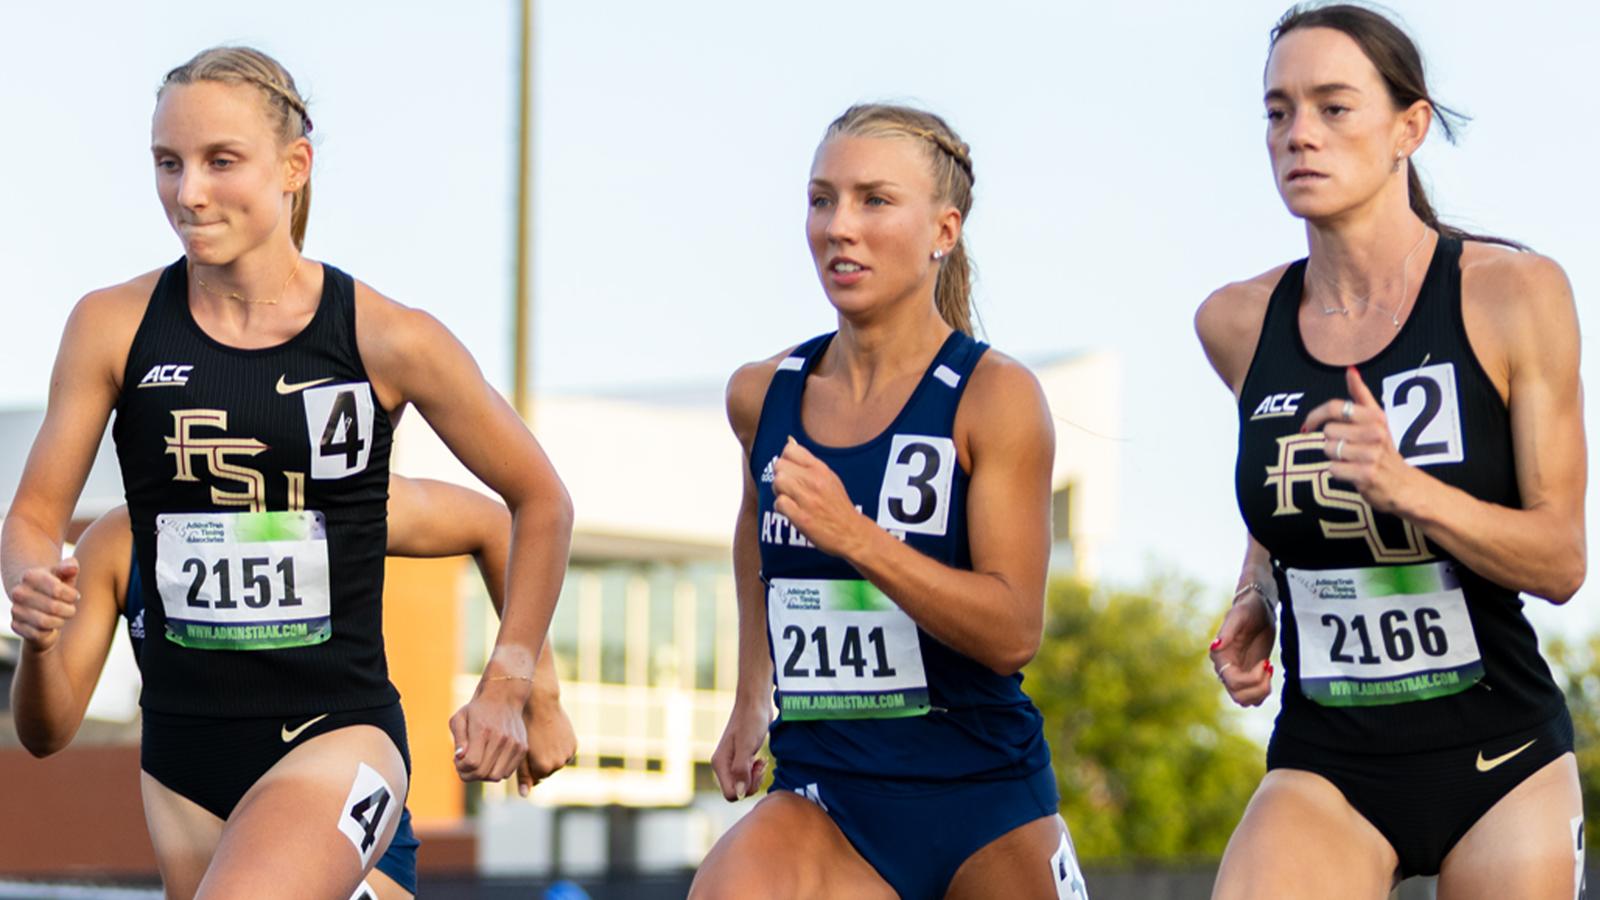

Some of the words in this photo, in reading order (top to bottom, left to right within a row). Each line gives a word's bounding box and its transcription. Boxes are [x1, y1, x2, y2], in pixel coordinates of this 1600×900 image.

[141, 365, 193, 382] ACC
[1253, 393, 1304, 415] ACC
[1392, 376, 1449, 459] 2
[320, 391, 365, 470] 4
[888, 442, 941, 524] 3
[182, 557, 302, 609] 2151
[186, 623, 308, 639] WWW.ADKINSTRAK.COM
[783, 625, 896, 678] 2141
[1321, 607, 1448, 664] 2166
[782, 693, 905, 710] WWW.ADKINSTRAK.COM
[1329, 671, 1459, 696] WWW.ADKINSTRAK.COM
[349, 786, 391, 854] 4
